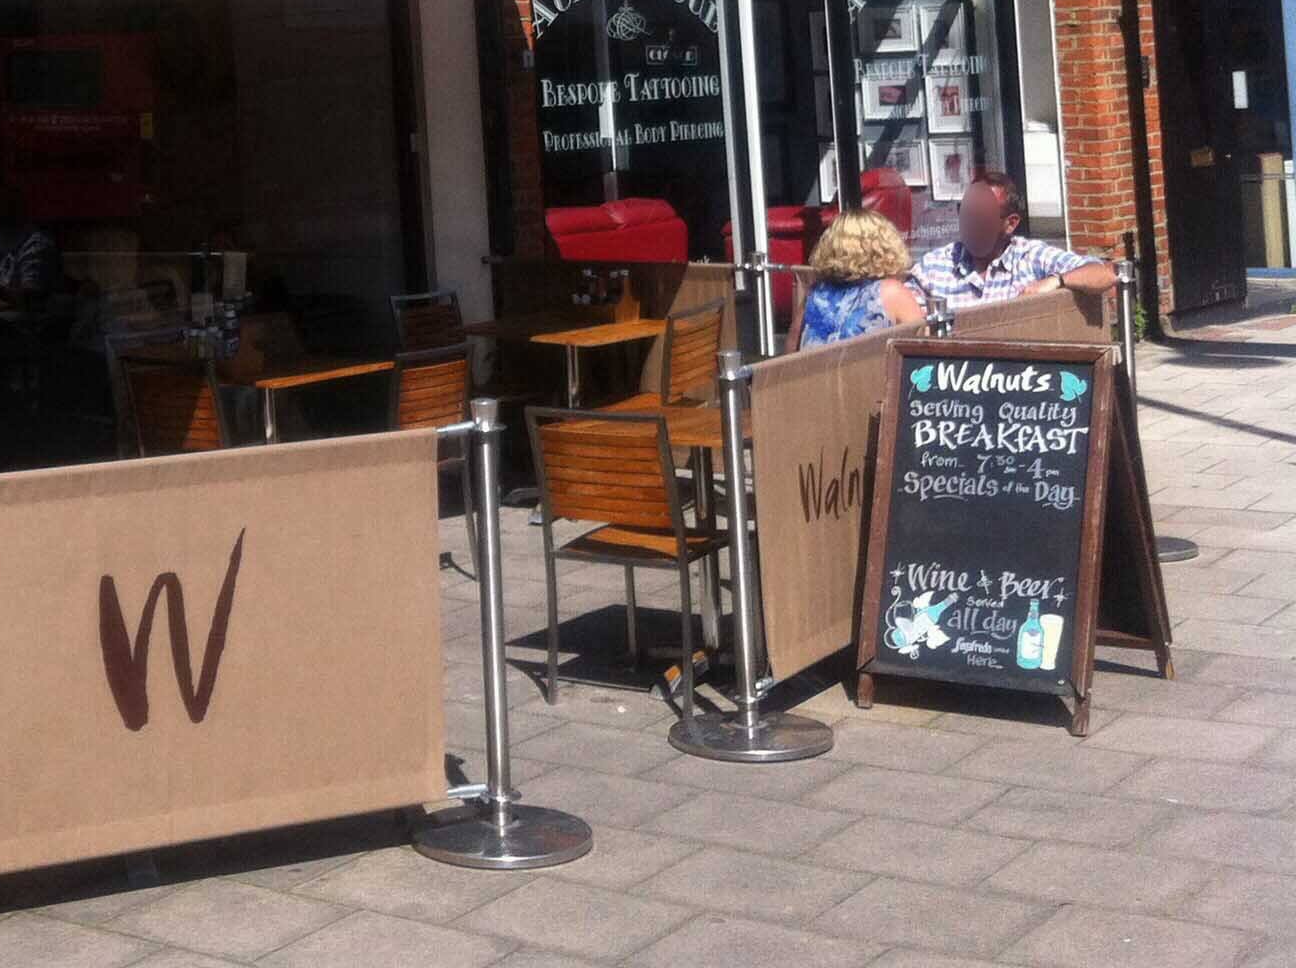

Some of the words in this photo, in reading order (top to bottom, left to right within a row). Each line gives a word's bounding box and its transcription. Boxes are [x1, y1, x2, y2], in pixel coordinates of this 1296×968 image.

[540, 79, 621, 108] BESPOKE
[624, 72, 720, 102] TATTOOING
[634, 123, 667, 145] BODY
[937, 361, 1053, 394] Walnuts
[909, 399, 984, 425] Serving
[998, 401, 1077, 427] Quality
[921, 451, 958, 468] from
[799, 445, 862, 523] Waln
[904, 471, 999, 501] Specials
[1034, 481, 1075, 510] Day
[907, 562, 973, 591] Wine
[998, 571, 1065, 600] Beer
[98, 527, 246, 731] W
[947, 607, 979, 632] all
[982, 610, 1017, 634] day
